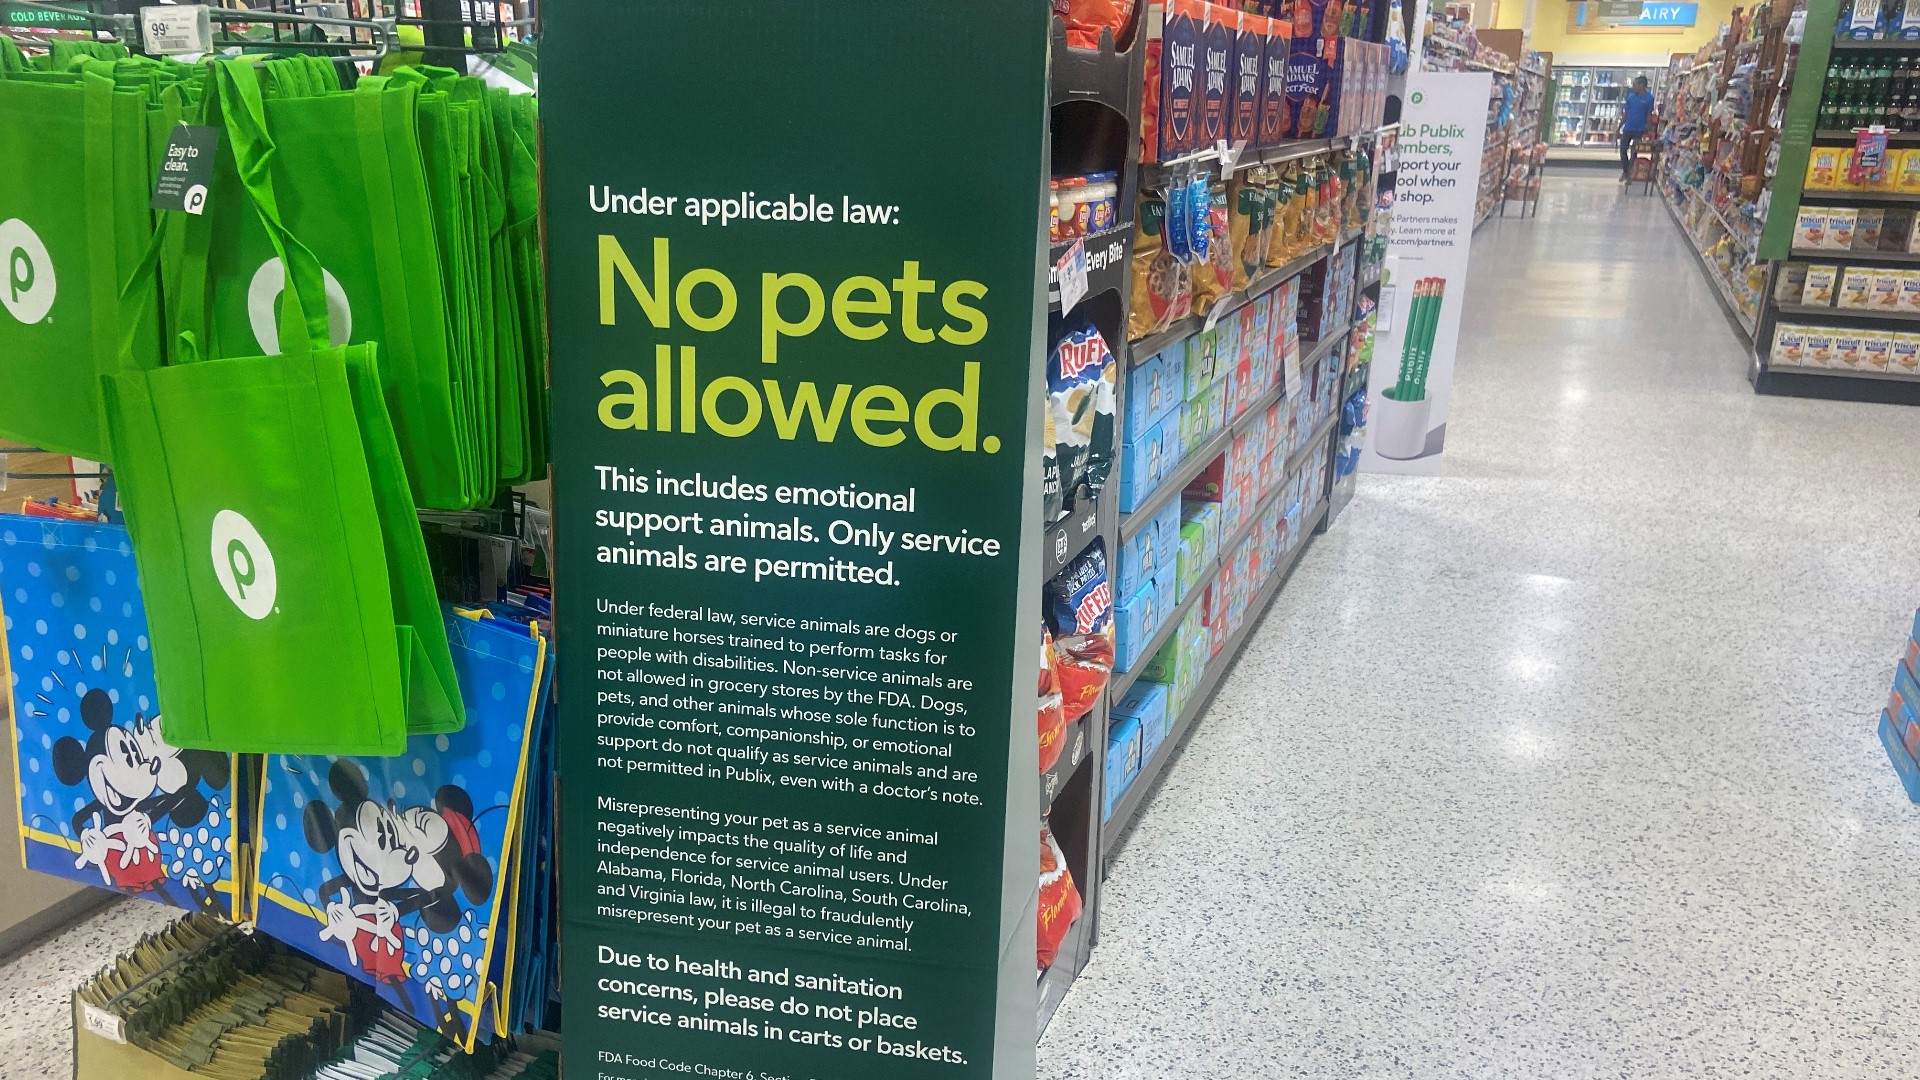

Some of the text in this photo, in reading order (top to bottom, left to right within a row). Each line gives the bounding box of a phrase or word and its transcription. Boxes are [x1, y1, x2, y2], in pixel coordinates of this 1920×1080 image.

[11, 12, 35, 22] COLD
[1639, 7, 1681, 20] AIRY
[1171, 41, 1195, 69] SAMUEL
[1206, 47, 1227, 73] SAMUEL
[1239, 53, 1258, 76] SAMUEL
[1172, 67, 1193, 93] ADAMS
[1206, 71, 1225, 94] ADAMS
[1240, 75, 1256, 96] ADAMS
[1399, 140, 1453, 156] embers,
[1420, 123, 1465, 138] Publix
[164, 158, 189, 172] clean.
[168, 144, 199, 160] Easy to
[1431, 161, 1461, 174] your
[1400, 190, 1434, 206] shop.
[1420, 174, 1456, 187] when
[589, 184, 900, 227] Under applicable law:
[1396, 214, 1430, 224] Partners
[1431, 215, 1458, 224] makes
[1399, 226, 1421, 235] Learn
[1424, 227, 1446, 236] more
[1447, 227, 1456, 236] at
[1086, 248, 1108, 273] Every
[597, 234, 989, 364] No pets
[597, 343, 1001, 454] allowed.
[594, 465, 916, 513] This includes emotional
[595, 509, 1001, 557] support animals. Only service
[596, 540, 901, 587] animals are permitted.
[596, 598, 958, 645] Under federal law, service animals are dogs or
[597, 624, 948, 665] miniature horses trained to perform tasks for
[597, 646, 973, 691] people with disabilities. Non-service animals are
[597, 690, 976, 737] pets, and other animals whose sole function is to
[597, 712, 952, 758] provide comfort, companionship, or emotional
[597, 756, 983, 806] not permitted in Publix, even with a doctor's note.
[597, 795, 938, 846] Misrepresenting your pet as a service animal
[597, 821, 907, 864] negatively impacts the quality of life and
[596, 860, 972, 917] Alabama, Florida, North Carolina, South Carolina,
[597, 905, 912, 952] misrepresent your pet as a service animal.
[598, 944, 903, 1000] Due to health and sanitation
[597, 978, 918, 1030] concerns, please do not place
[597, 1004, 968, 1065] service animals in carts or baskets.
[598, 1050, 623, 1065] FDA
[625, 1055, 656, 1069] Food
[659, 1059, 692, 1073] Code
[694, 1064, 743, 1080] Chapter
